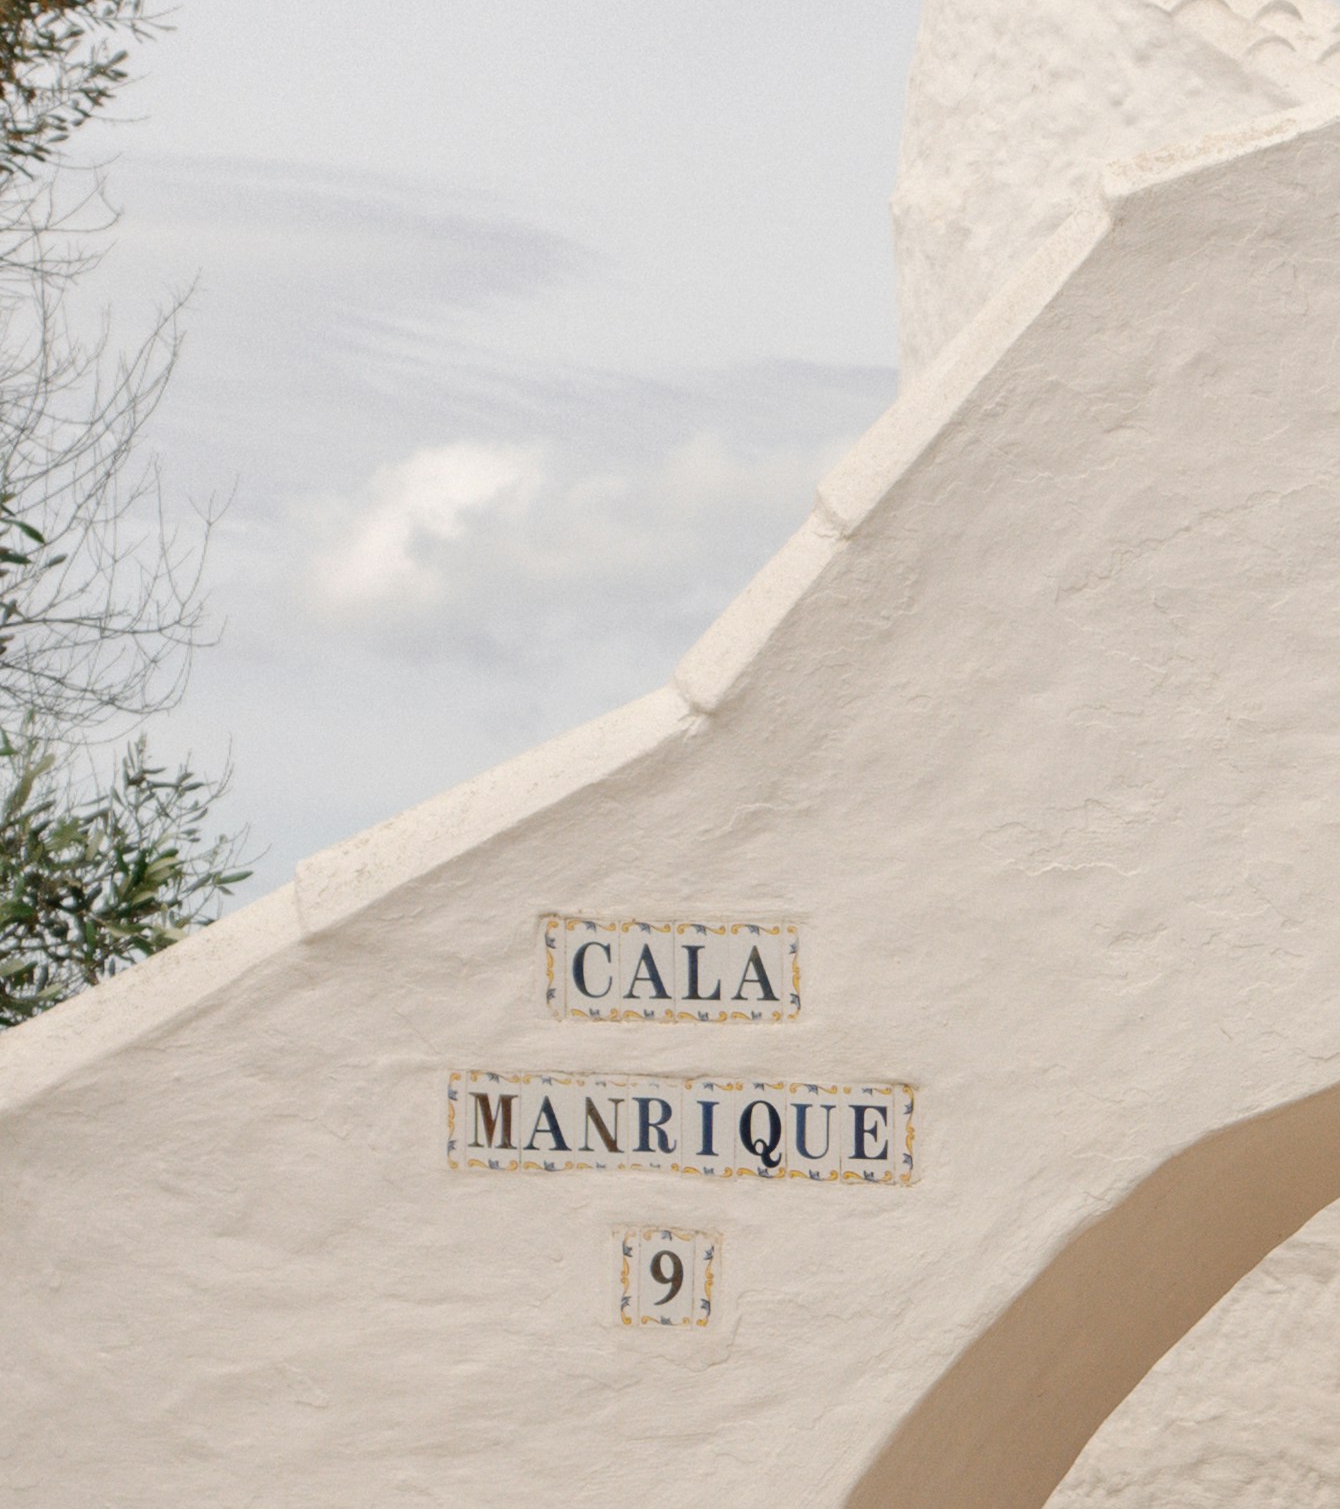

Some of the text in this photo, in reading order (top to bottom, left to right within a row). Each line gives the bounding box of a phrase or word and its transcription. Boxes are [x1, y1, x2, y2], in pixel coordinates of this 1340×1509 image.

[572, 941, 780, 1002] CALA
[467, 1092, 890, 1169] MANRIQUE
[649, 1249, 684, 1306] 9
